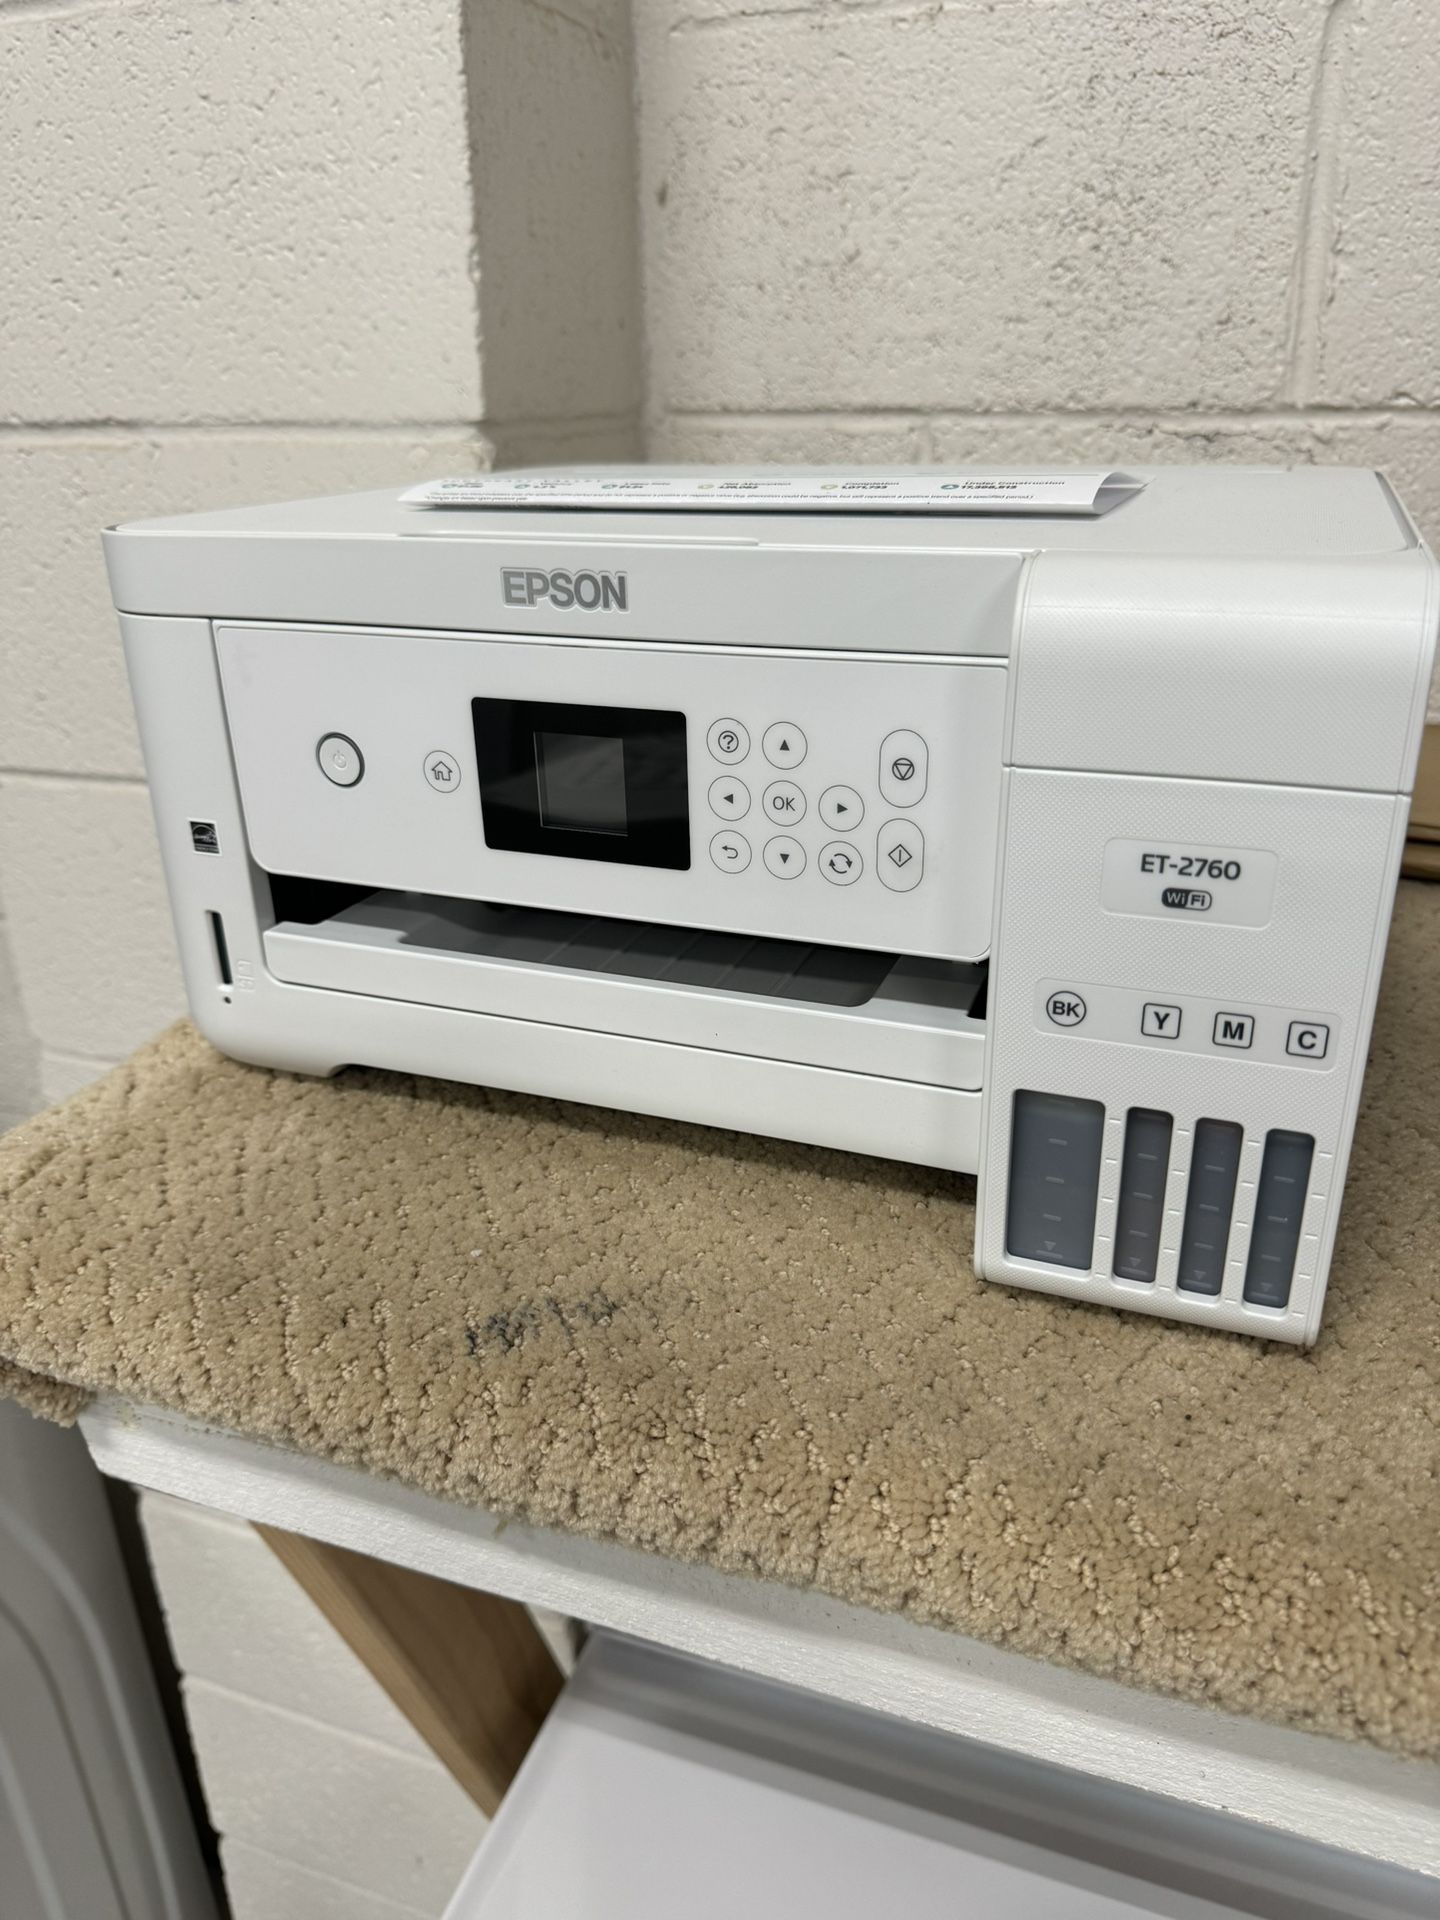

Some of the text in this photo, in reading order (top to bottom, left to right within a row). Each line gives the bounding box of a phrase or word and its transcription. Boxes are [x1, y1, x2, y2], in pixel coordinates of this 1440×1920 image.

[502, 570, 627, 610] EPSON
[772, 796, 795, 811] OK
[1140, 853, 1241, 881] ET-2760
[1052, 1000, 1317, 1050] BK Y M C
